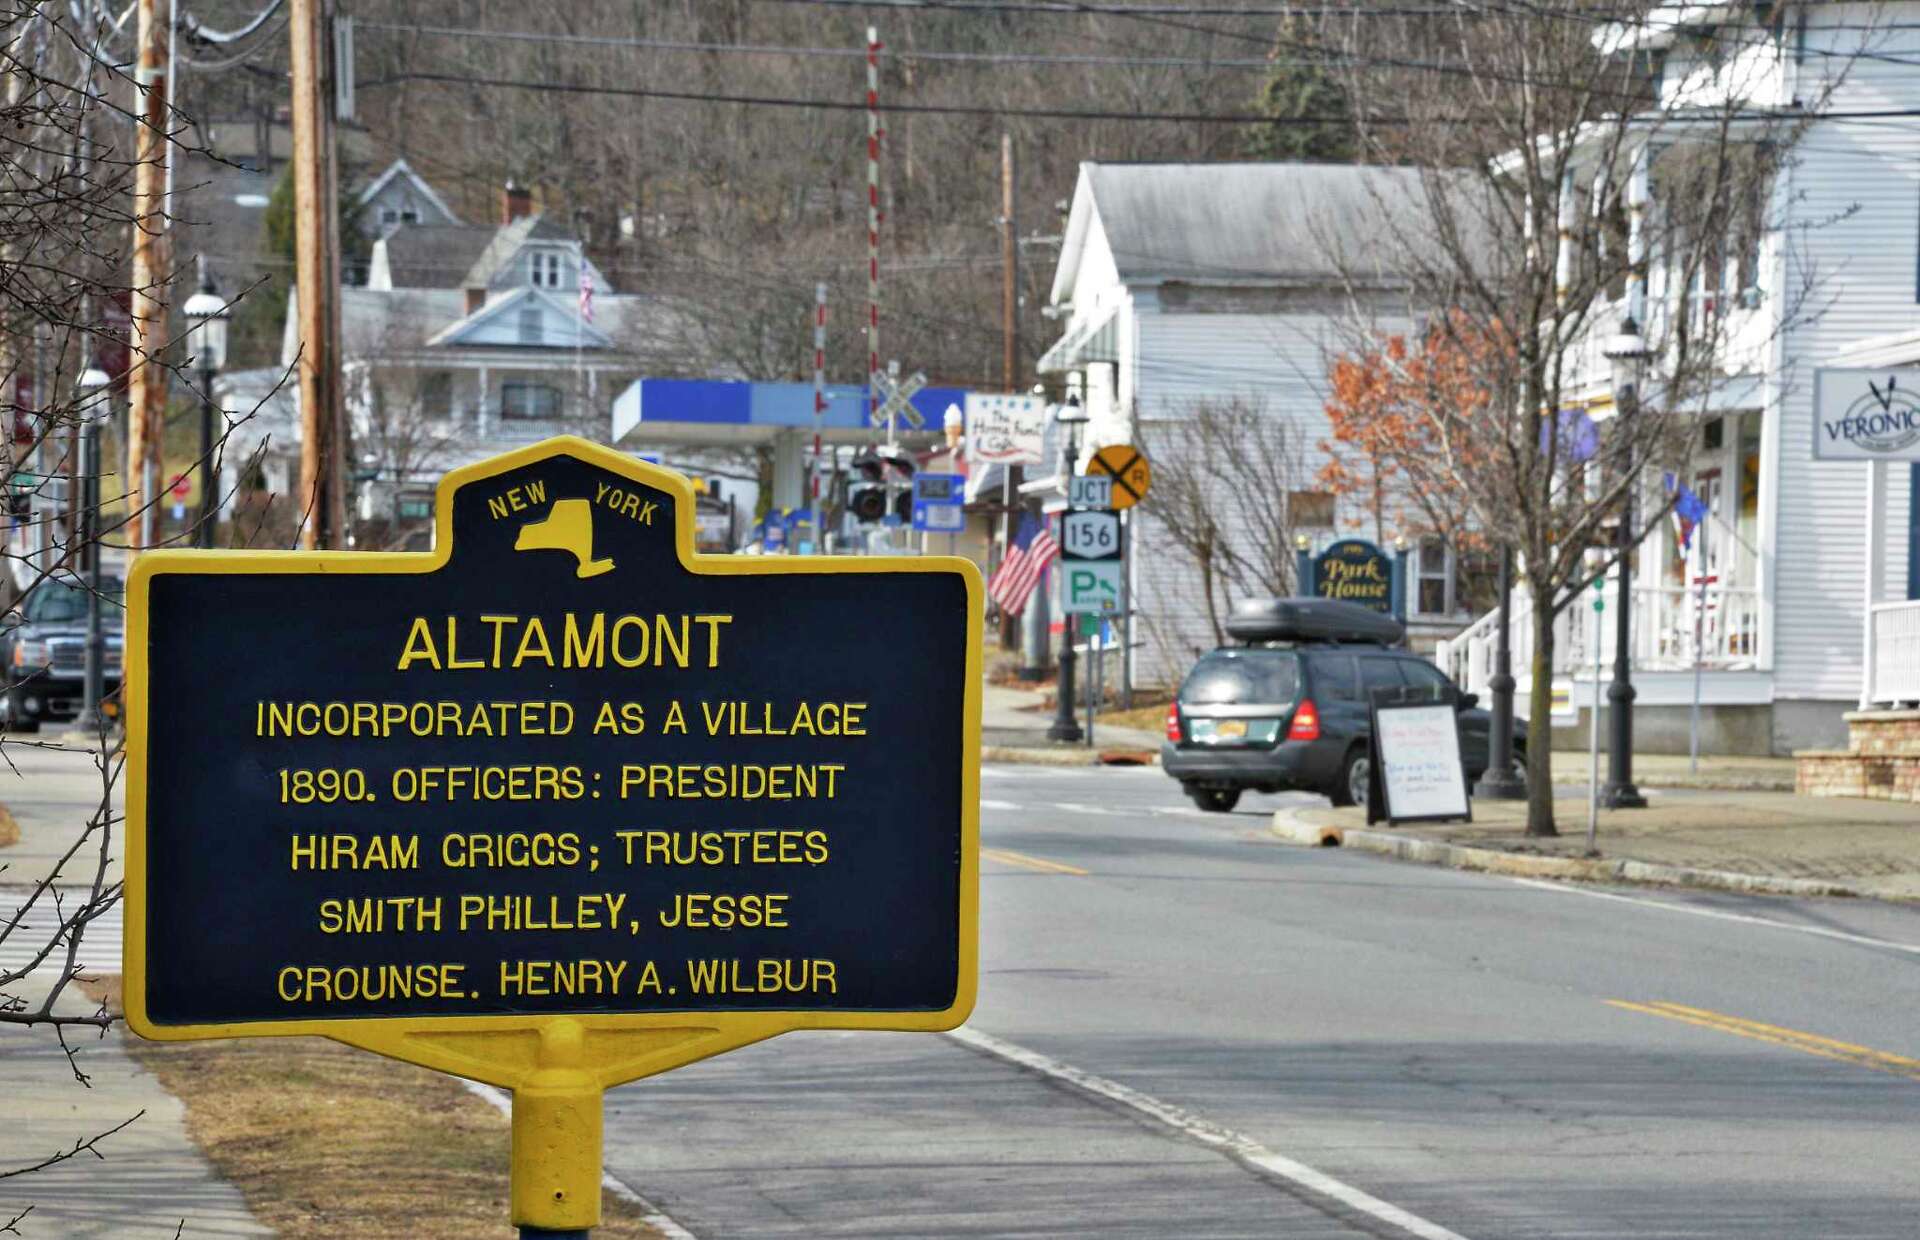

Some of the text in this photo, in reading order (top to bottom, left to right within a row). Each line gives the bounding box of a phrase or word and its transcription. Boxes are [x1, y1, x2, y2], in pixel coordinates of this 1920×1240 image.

[487, 480, 658, 526] NEW YORK
[1073, 481, 1108, 501] JCT
[1071, 522, 1111, 547] 156
[1071, 570, 1097, 604] P
[1324, 557, 1387, 580] Park
[1319, 579, 1387, 600] House
[398, 613, 733, 670] ALTAMONT
[256, 702, 867, 737] INCORPORATED AS A VILLAGE
[280, 764, 846, 803] 1890. OFFICERS: PRESIDENT
[291, 830, 829, 873] HIRAM GRIGGS; TRUSTEES
[319, 893, 789, 935] SMITH PHILLEY, JESSE
[278, 959, 837, 1001] CROUNSE. HENRY A. WILBUR
